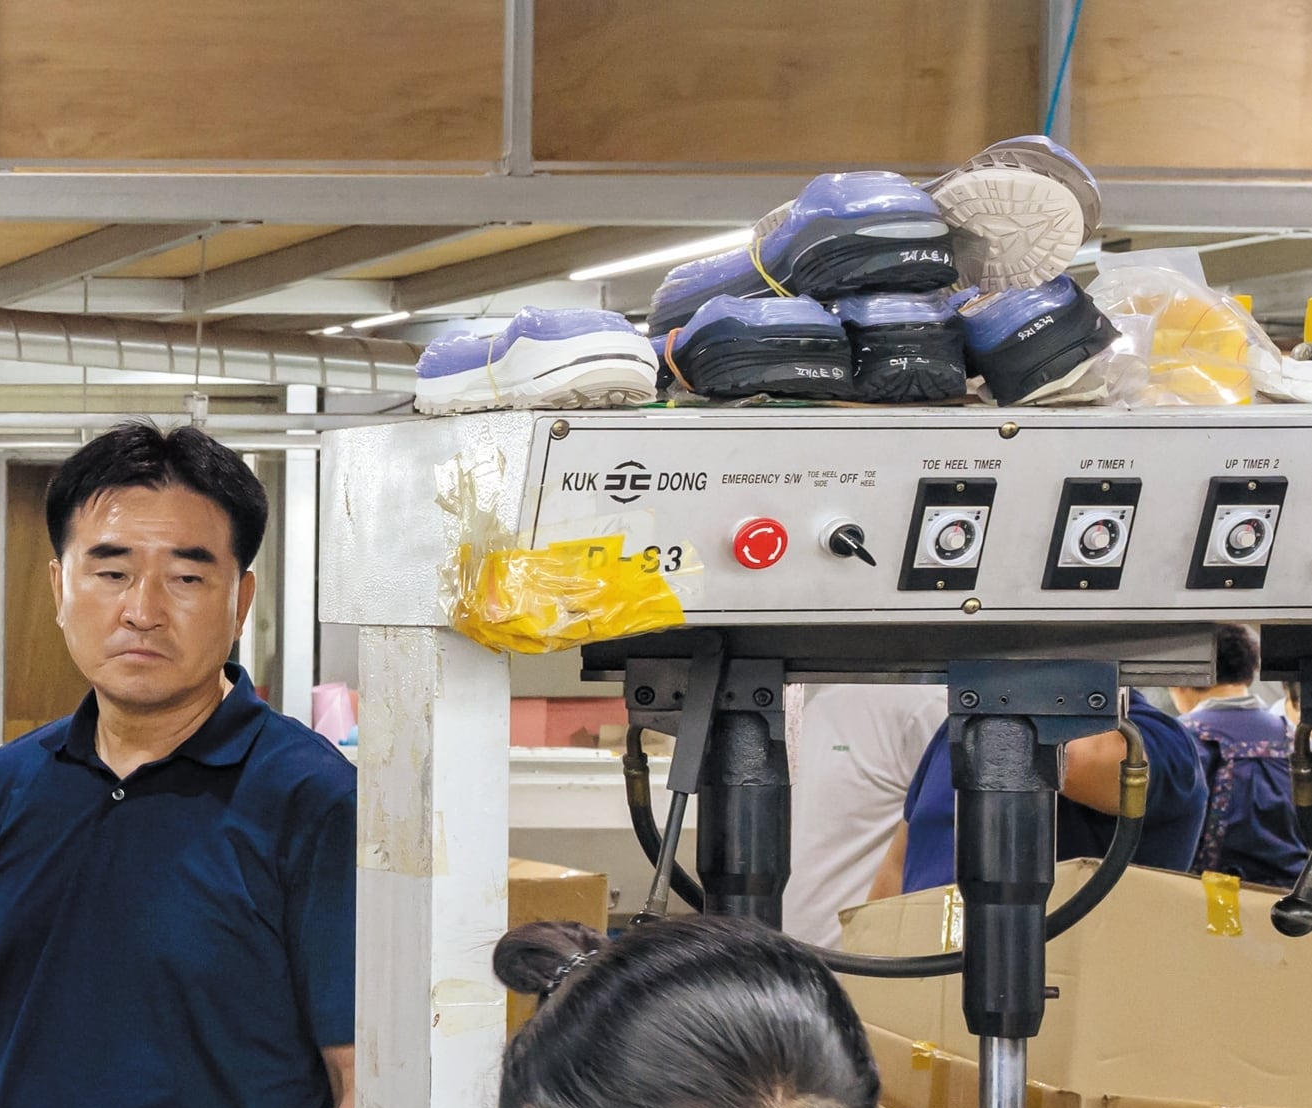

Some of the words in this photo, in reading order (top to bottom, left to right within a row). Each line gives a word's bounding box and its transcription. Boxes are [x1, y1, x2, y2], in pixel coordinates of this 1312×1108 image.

[921, 459, 941, 470] TOE
[944, 459, 969, 470] HEEL
[973, 459, 1002, 470] TIMER
[1079, 460, 1095, 470] UP
[1097, 460, 1126, 470] TIMER
[1129, 460, 1135, 469] 1
[1224, 459, 1239, 469] UP
[1241, 459, 1271, 469] TIMER
[1273, 459, 1280, 469] 2
[721, 473, 780, 484] EMERGENCY
[784, 473, 803, 484] S/W
[807, 470, 820, 479] TOE
[839, 473, 859, 484] OFF
[562, 472, 598, 491] KUK
[657, 472, 708, 492] DONG
[813, 479, 829, 488] SIDE
